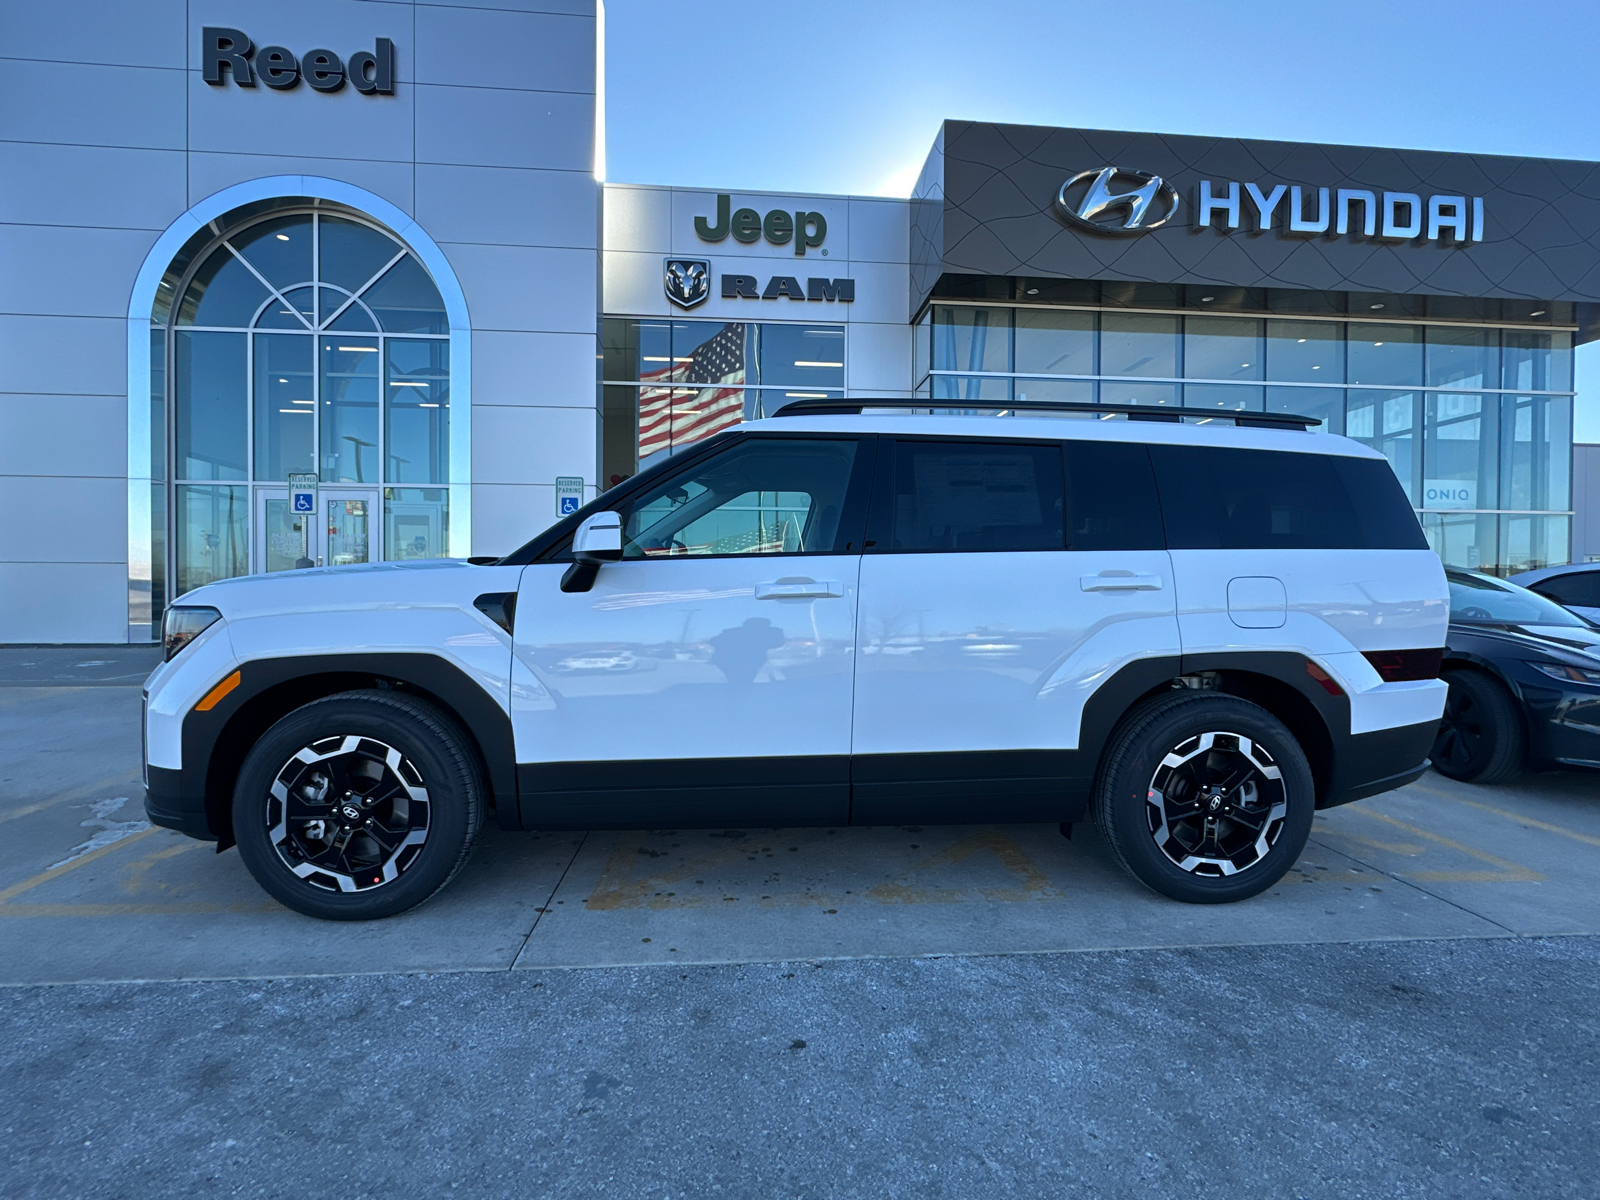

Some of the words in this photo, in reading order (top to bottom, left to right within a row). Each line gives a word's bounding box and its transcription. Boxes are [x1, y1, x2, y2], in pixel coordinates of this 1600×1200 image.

[202, 26, 394, 95] Reed
[694, 194, 827, 255] Jeep
[1198, 180, 1484, 242] HYUNDAI
[721, 274, 855, 302] RAM
